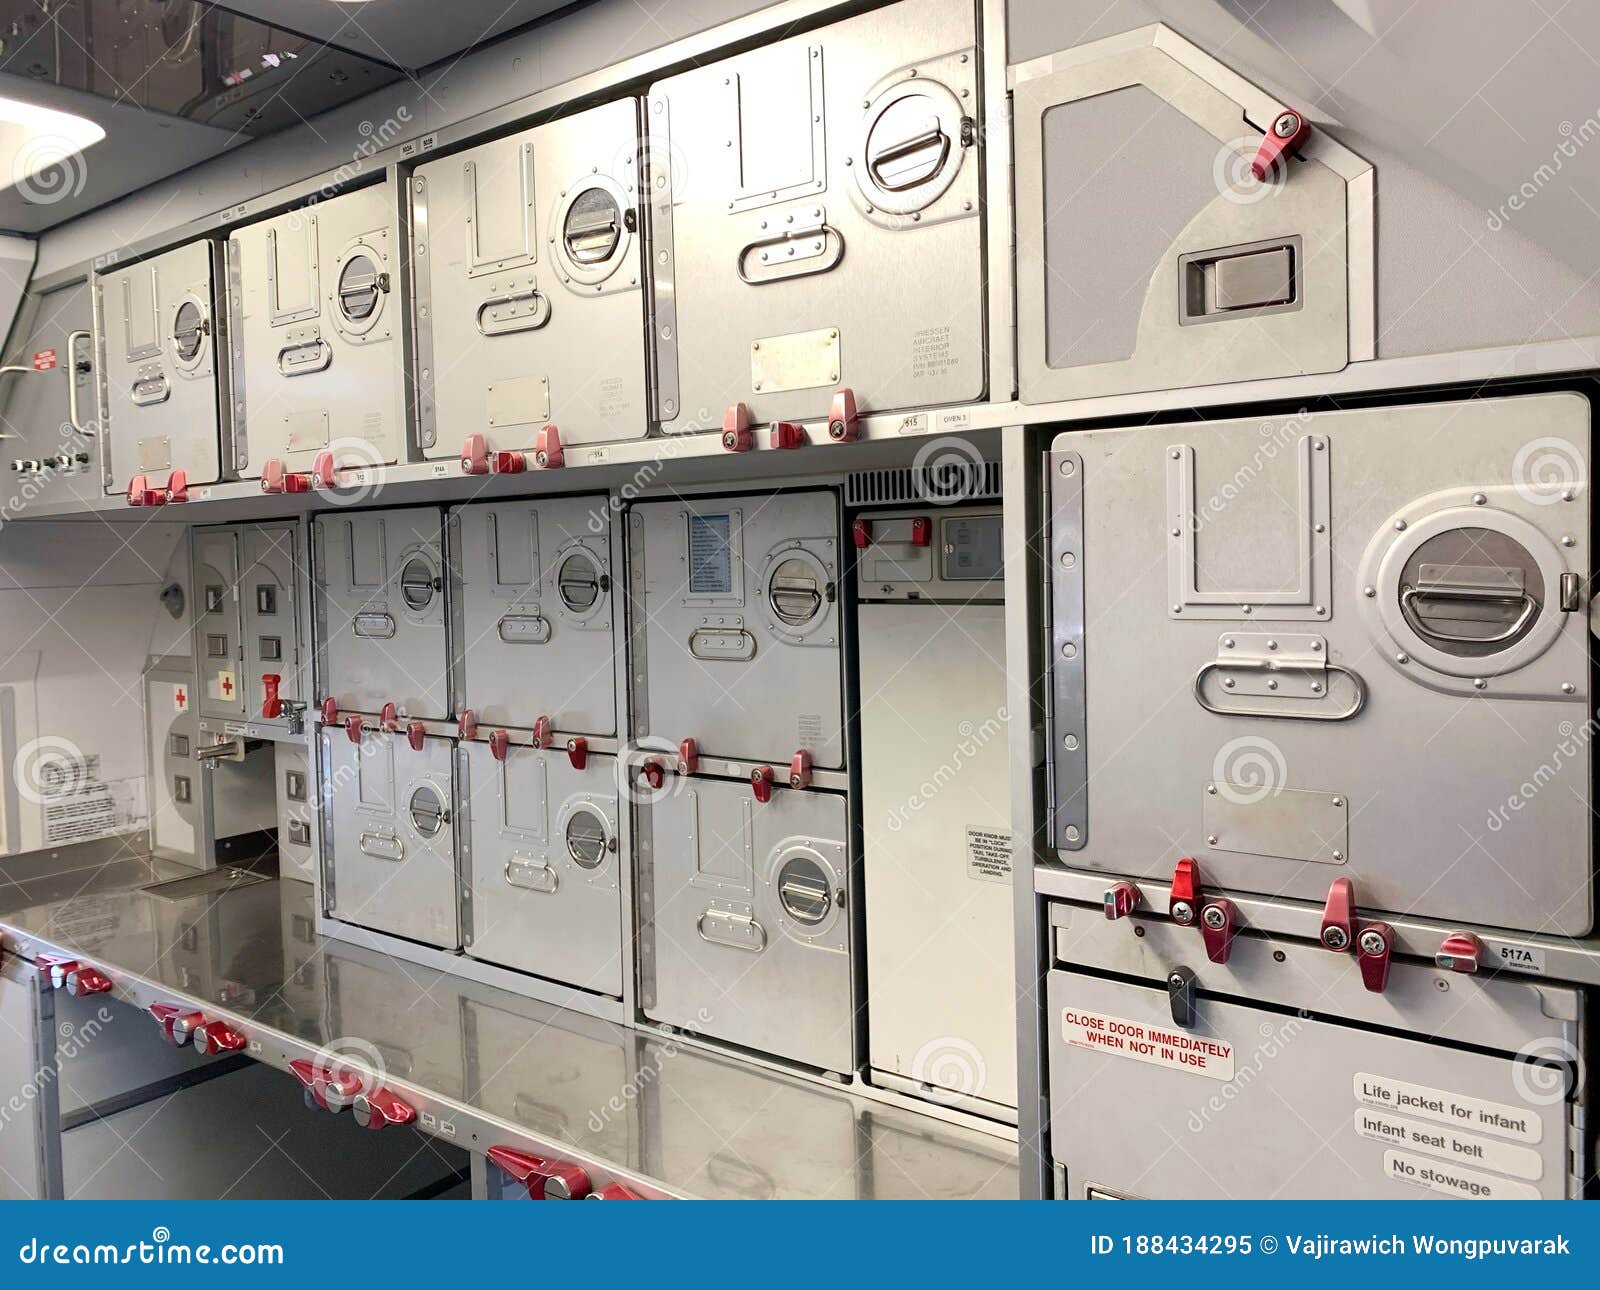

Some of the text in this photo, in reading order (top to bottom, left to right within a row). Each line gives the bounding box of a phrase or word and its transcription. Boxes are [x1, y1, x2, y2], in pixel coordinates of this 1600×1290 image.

[1501, 947, 1533, 962] 517A
[1066, 1012, 1231, 1059] CLOSE DOOR IMMEDIATELY
[1086, 1030, 1124, 1048] WHEN
[1129, 1041, 1156, 1056] NOT
[1161, 1048, 1174, 1061] IN
[1179, 1052, 1206, 1068] USE
[1363, 1083, 1391, 1100] Life
[1397, 1091, 1445, 1113] jacket
[1450, 1104, 1473, 1120] for
[1479, 1110, 1527, 1133] infant
[1363, 1117, 1406, 1139] Infant
[1412, 1129, 1446, 1149] seat
[1452, 1139, 1484, 1158] belt
[1393, 1159, 1416, 1176] No
[1420, 1169, 1491, 1197] stowage
